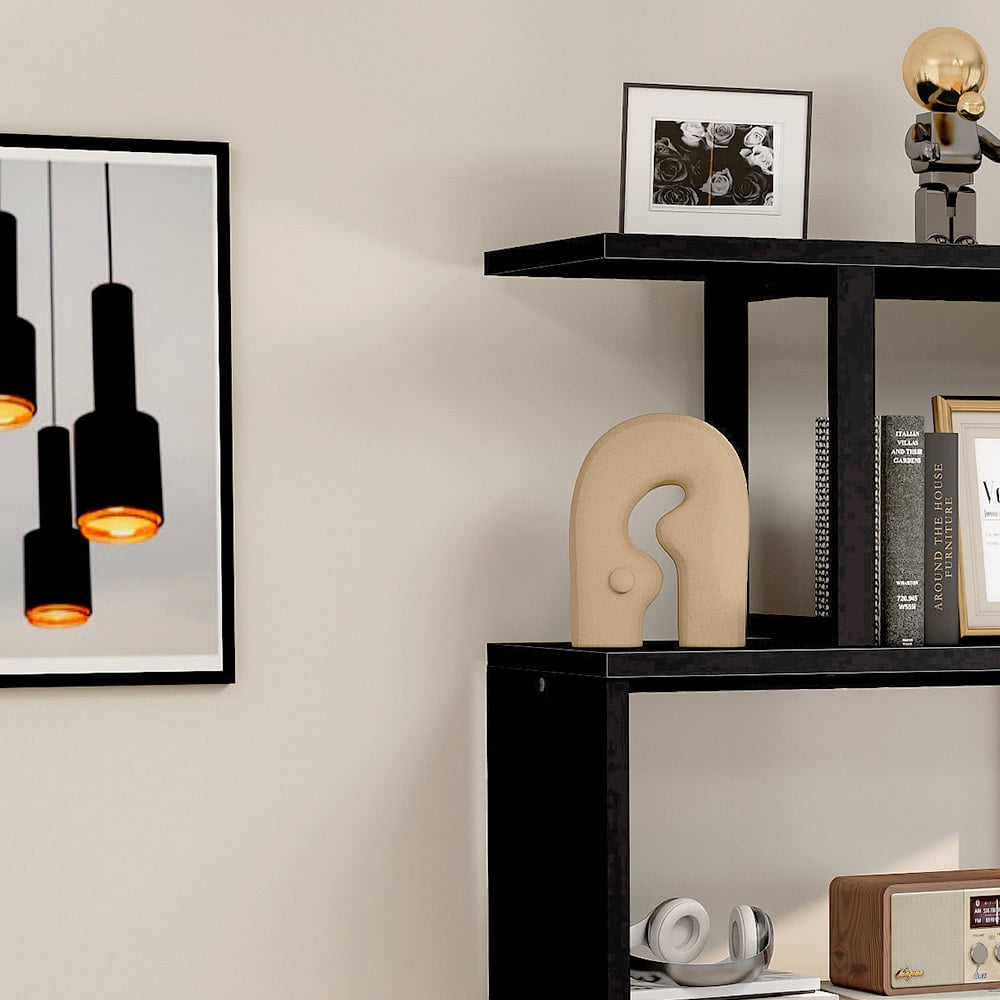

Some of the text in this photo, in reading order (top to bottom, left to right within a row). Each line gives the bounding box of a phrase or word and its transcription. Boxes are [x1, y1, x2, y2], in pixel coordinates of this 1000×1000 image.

[933, 462, 943, 611] AROUND THE HOUSE
[944, 496, 953, 578] FURNITURE
